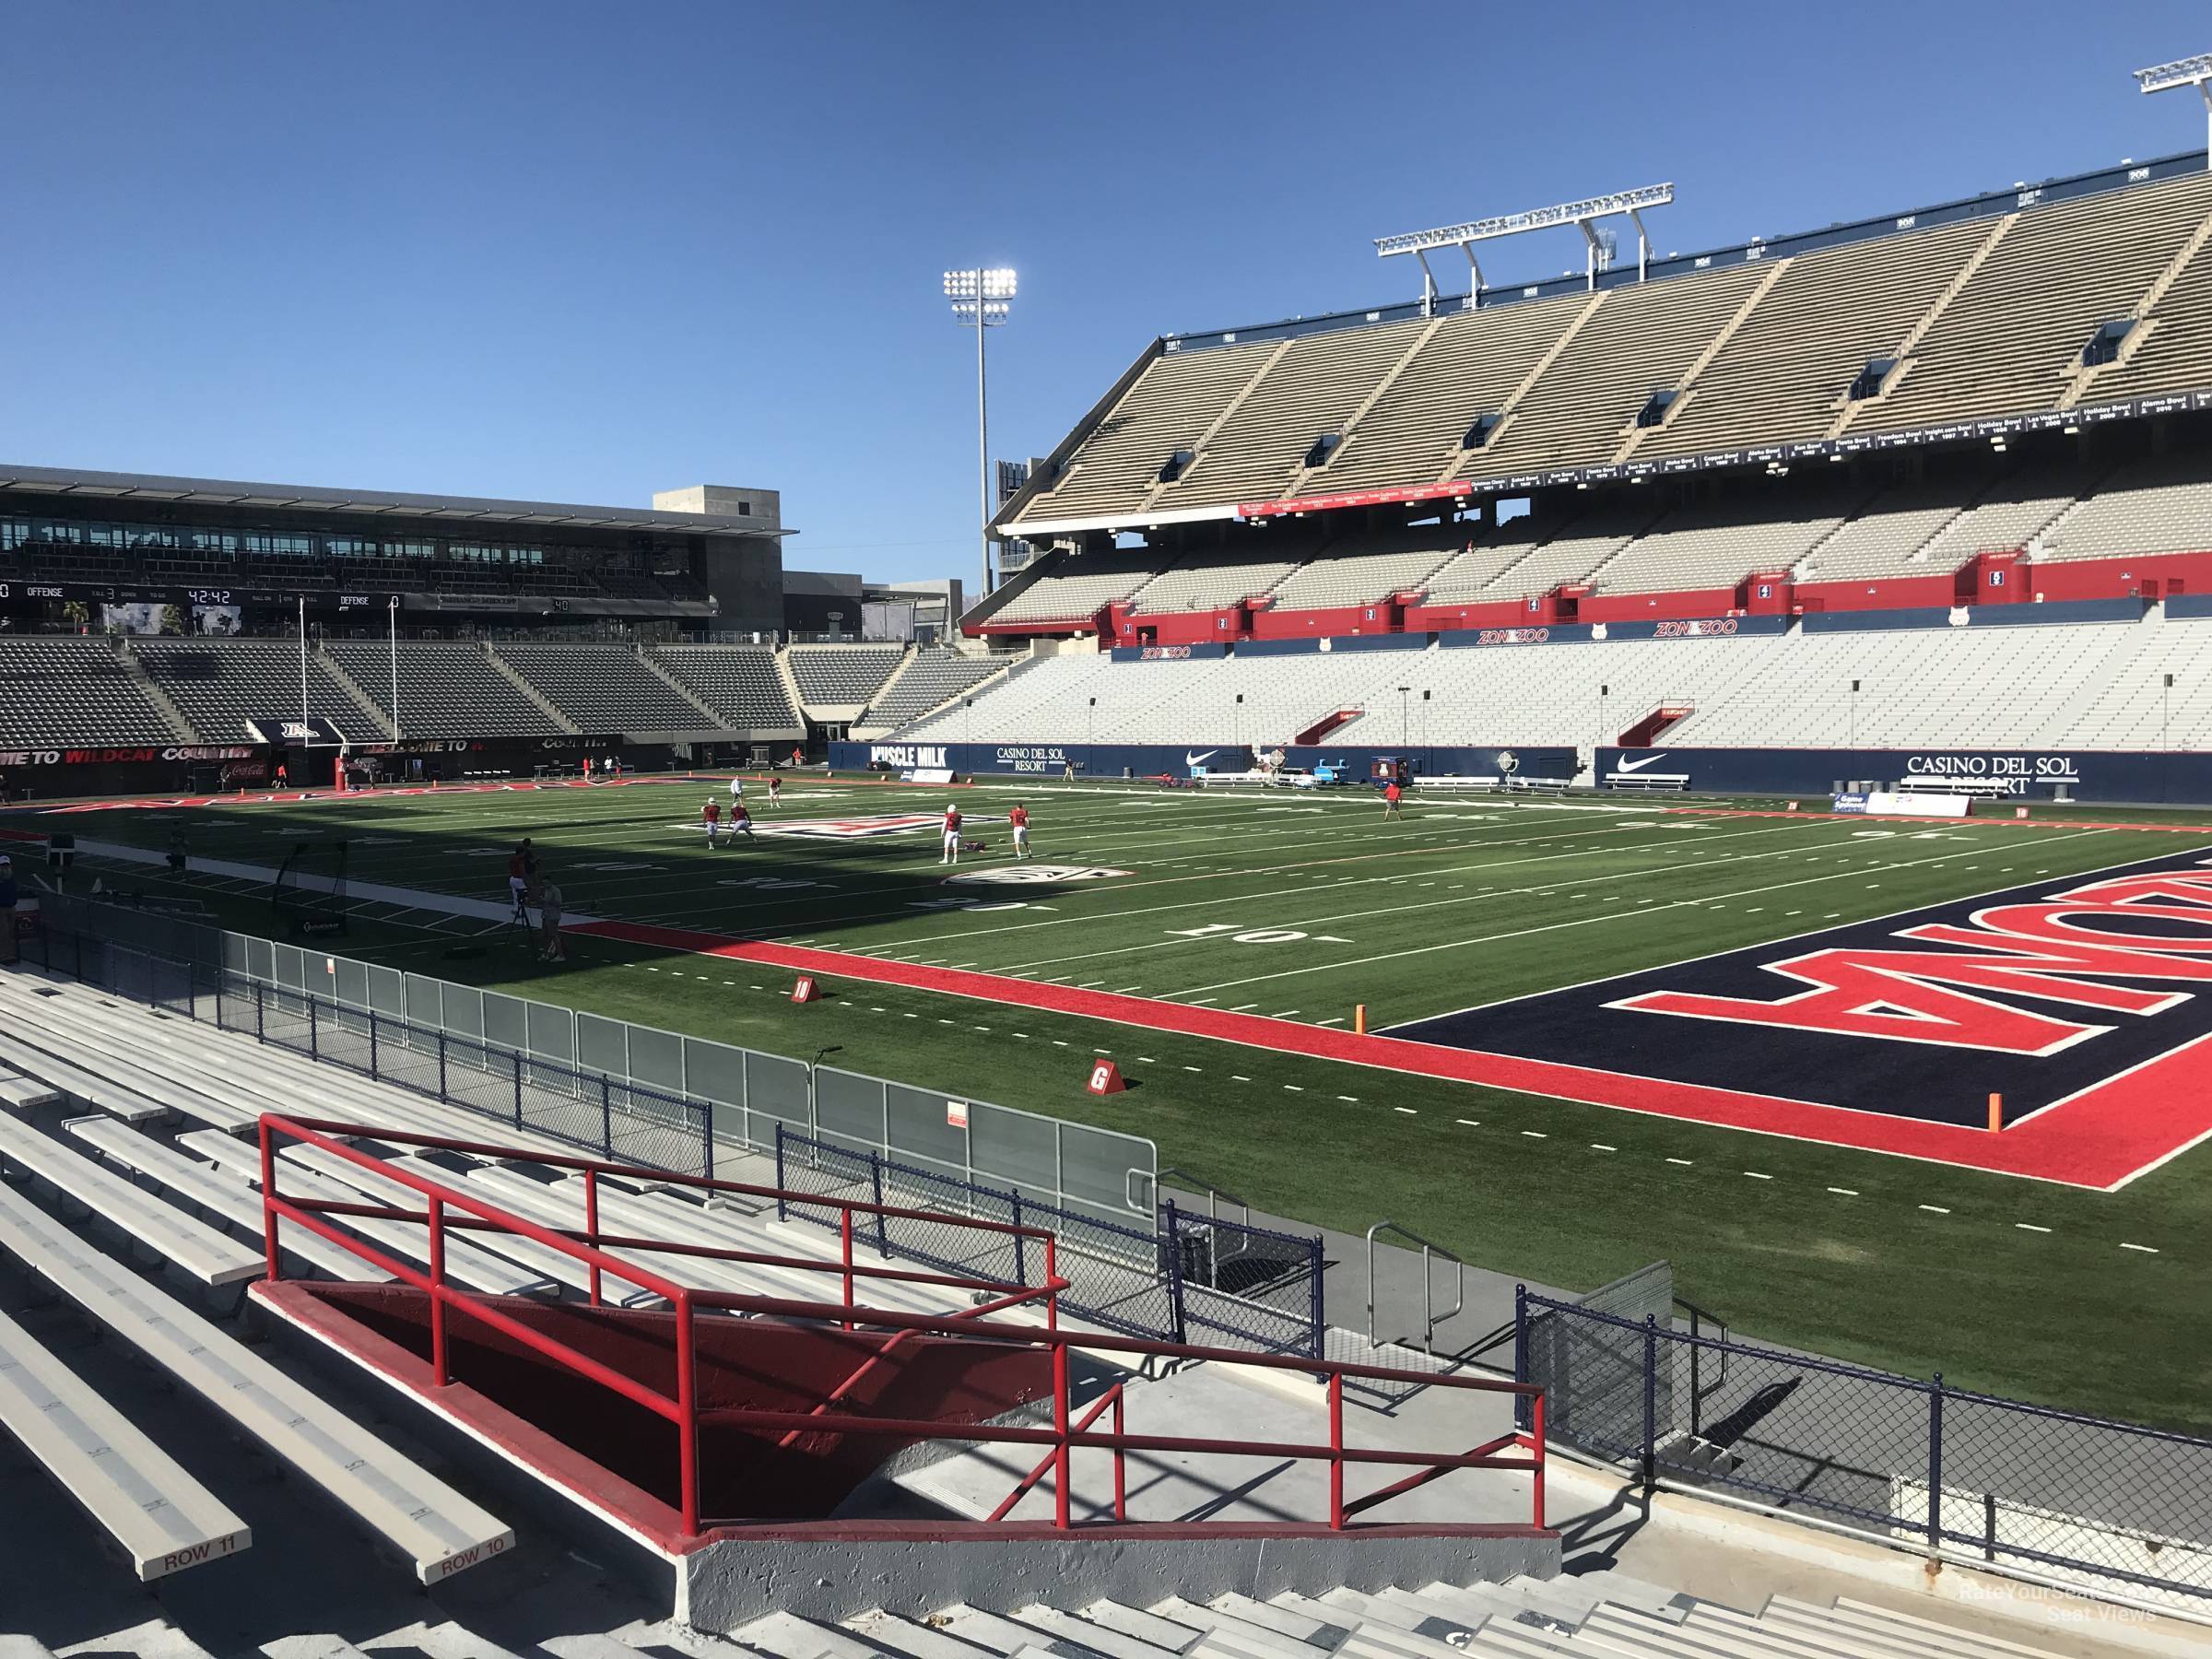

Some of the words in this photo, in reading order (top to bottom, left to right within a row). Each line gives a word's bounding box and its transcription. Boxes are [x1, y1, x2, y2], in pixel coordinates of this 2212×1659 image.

[1695, 256, 1711, 266] 204
[2167, 396, 2186, 405] Bowl
[2040, 414, 2059, 422] Vegas
[2061, 410, 2077, 418] Bowl
[2084, 406, 2111, 415] Holiday
[1977, 421, 2003, 429] Holiday
[27, 587, 64, 597] OFFENSE
[188, 590, 230, 604] 42:42
[340, 595, 369, 606] DEFENSE
[448, 740, 468, 752] TO
[33, 750, 60, 765] TO
[65, 748, 156, 764] WILDCAT
[917, 747, 947, 768] MILK
[997, 747, 1030, 759] CASINO
[1031, 748, 1047, 759] DEL
[1049, 748, 1065, 760] SOL
[1015, 760, 1047, 771] RESORT
[1907, 757, 1986, 774] CASINO
[1993, 758, 2032, 774] DEL
[2035, 758, 2078, 775] SOL
[1164, 924, 1309, 944] 10
[794, 980, 808, 1000] 10
[1090, 1066, 1109, 1092] G
[88, 1446, 114, 1458] 15
[345, 1459, 368, 1472] 15
[142, 1497, 169, 1512] 14
[409, 1506, 434, 1521] 14
[164, 1545, 210, 1571] ROW
[218, 1535, 236, 1554] 11
[441, 1547, 479, 1575] ROW
[486, 1538, 505, 1556] 10
